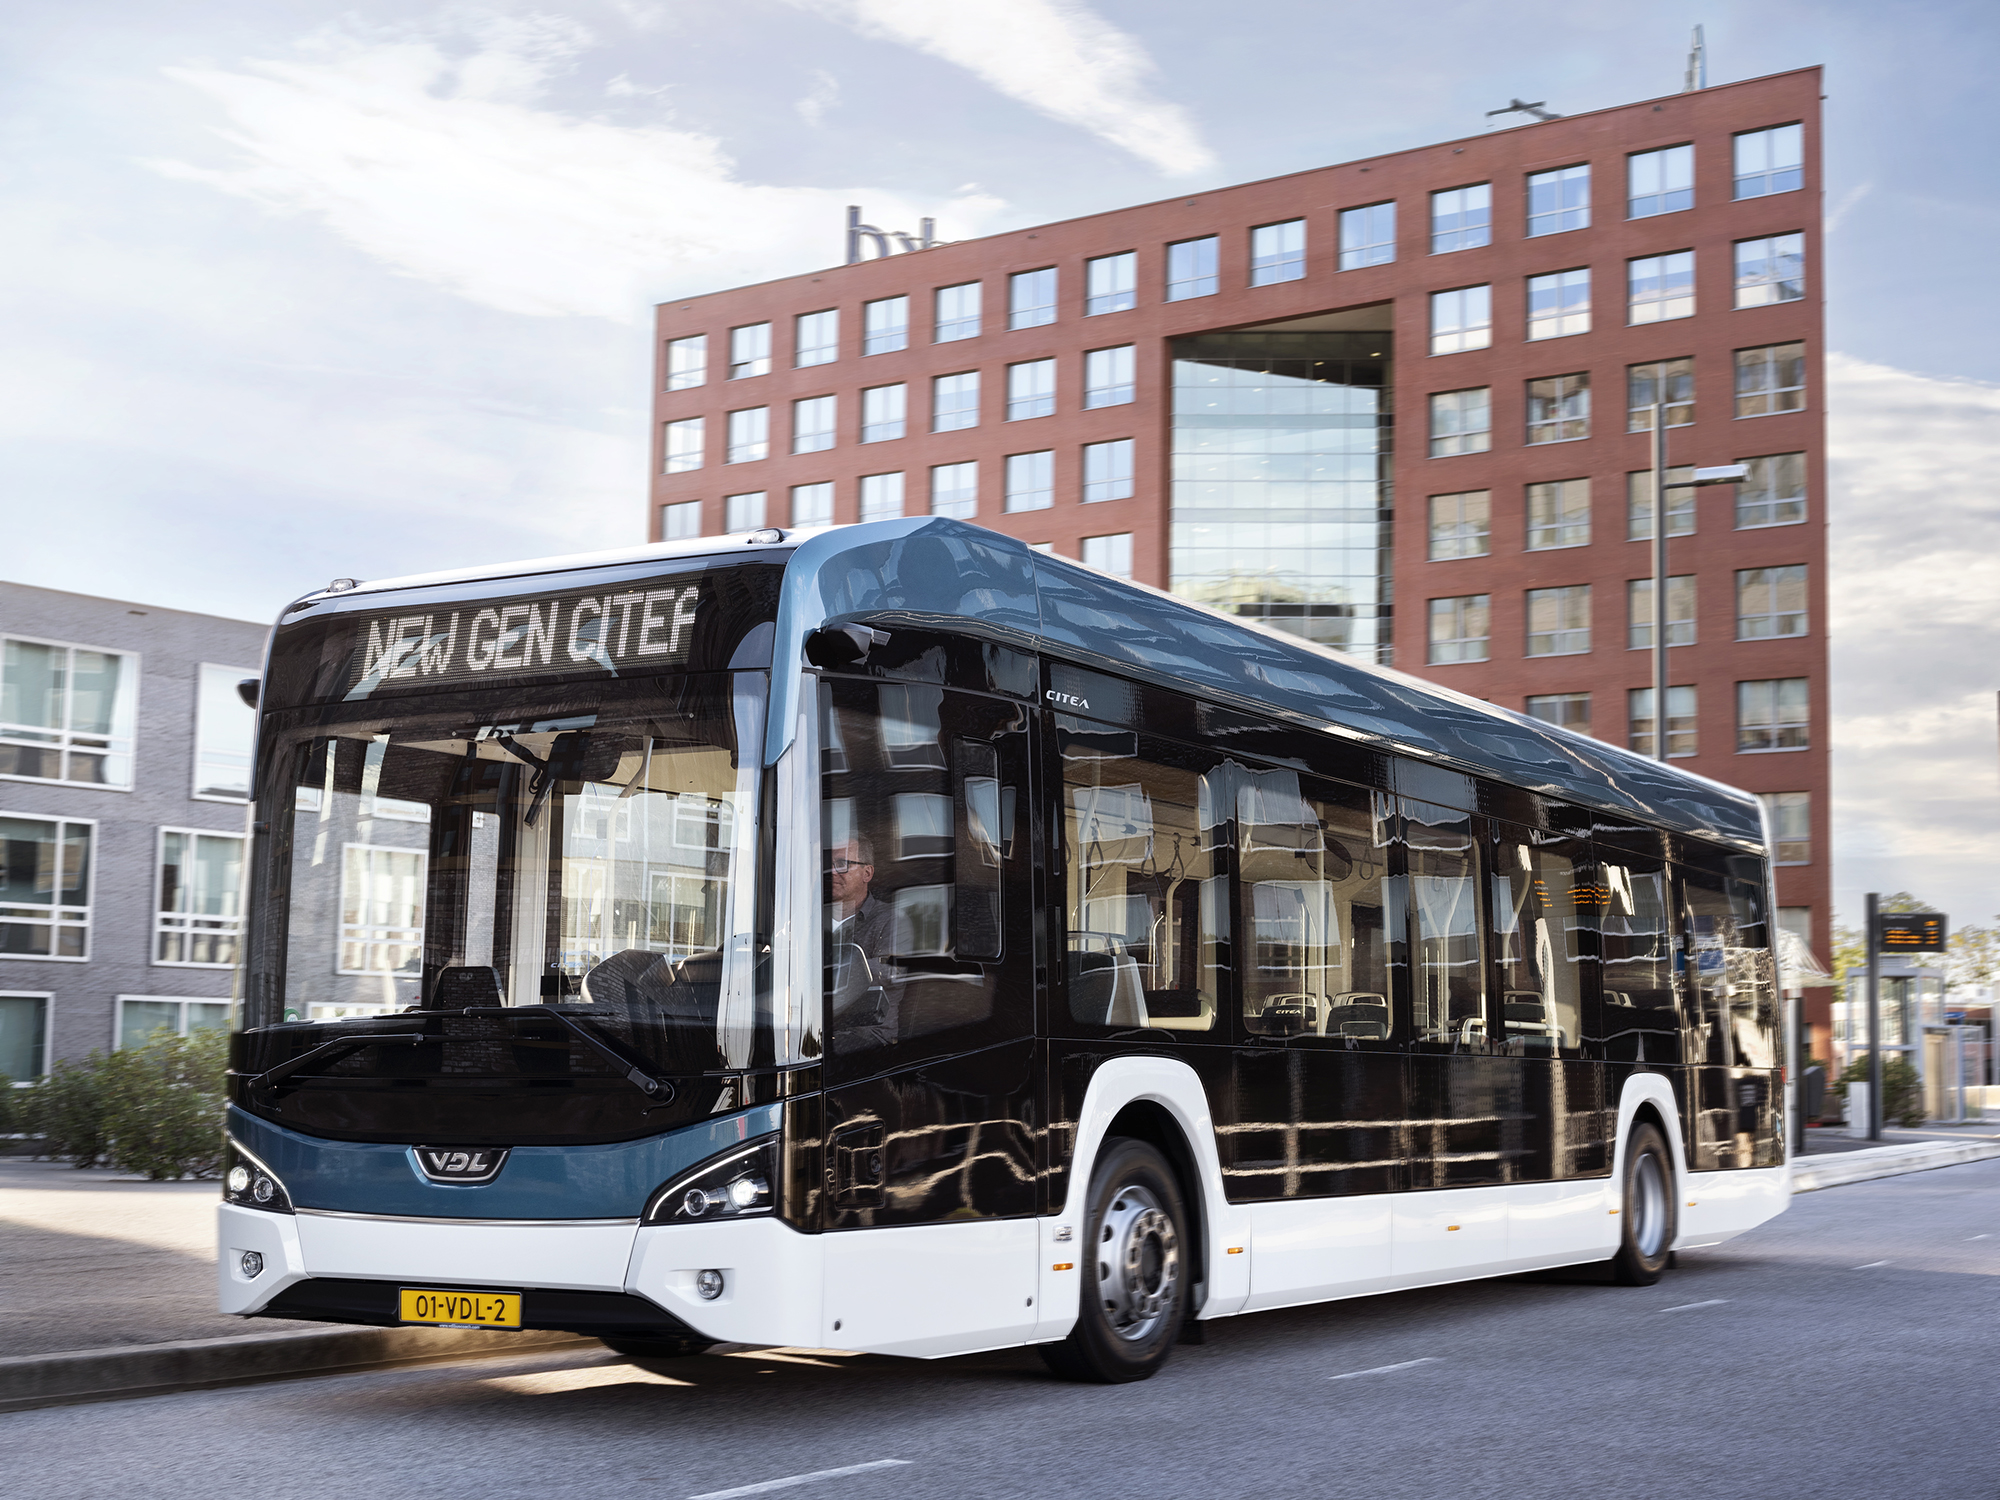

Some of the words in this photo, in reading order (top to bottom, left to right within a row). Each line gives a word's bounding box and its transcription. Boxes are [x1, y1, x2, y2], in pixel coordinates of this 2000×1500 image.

[362, 612, 460, 681] NEW
[467, 600, 559, 671] GEN
[1045, 689, 1090, 710] CITEA
[428, 1152, 488, 1172] VDL
[416, 1295, 506, 1322] 01-VDL-2
